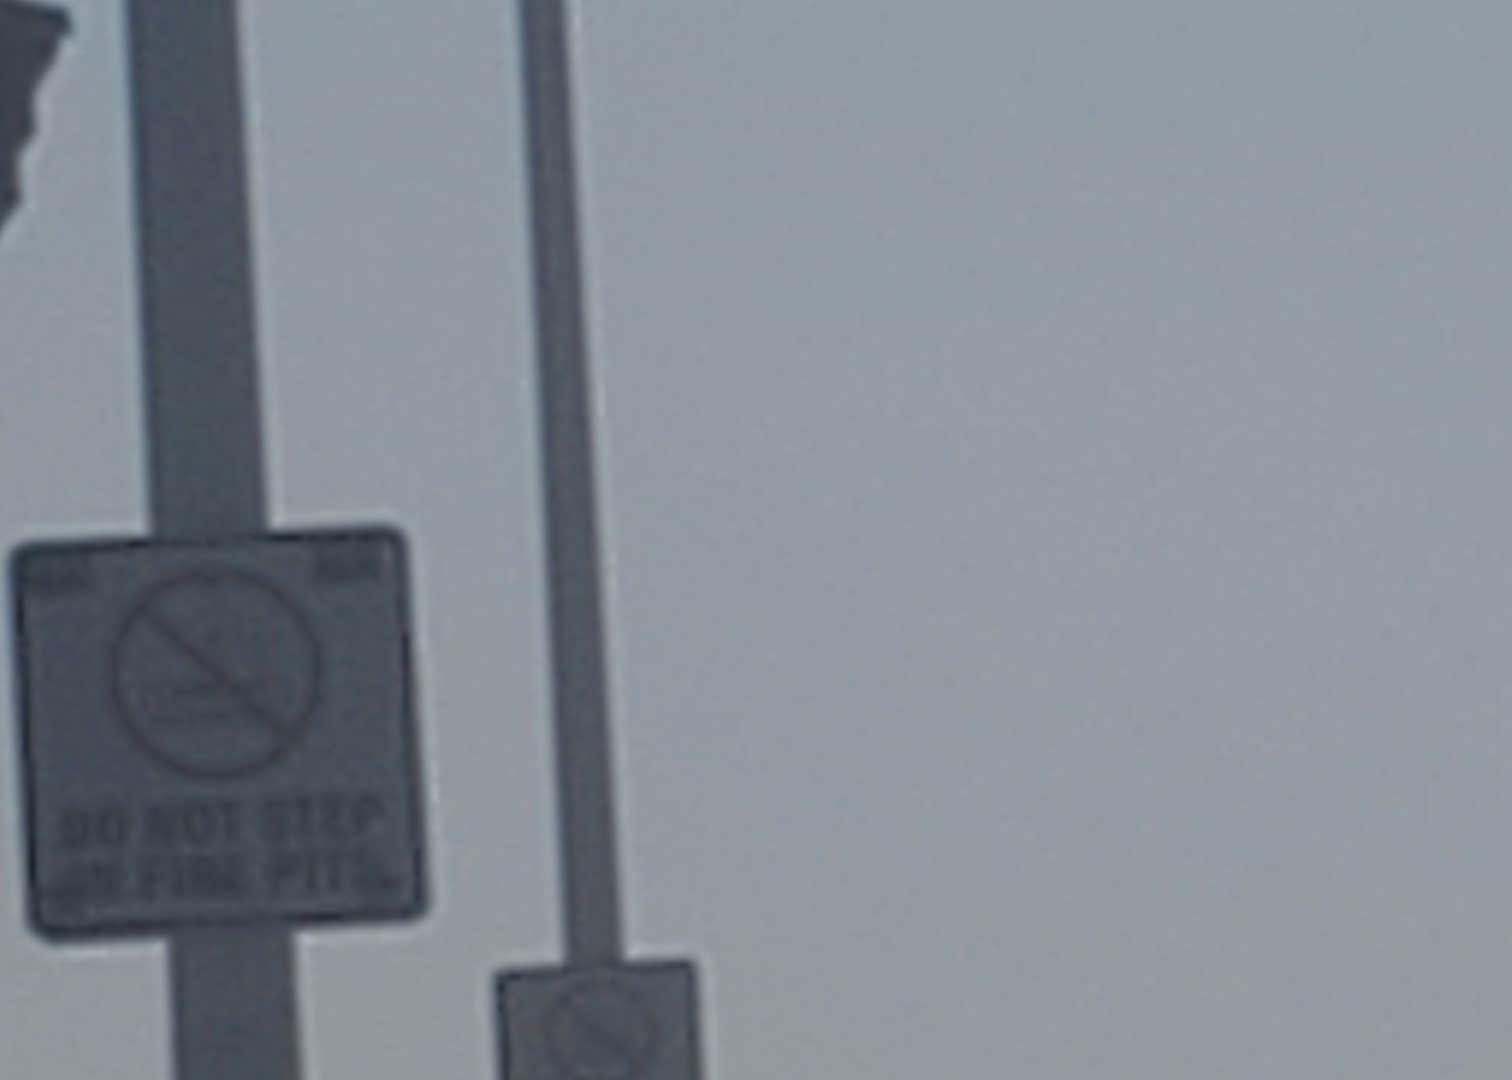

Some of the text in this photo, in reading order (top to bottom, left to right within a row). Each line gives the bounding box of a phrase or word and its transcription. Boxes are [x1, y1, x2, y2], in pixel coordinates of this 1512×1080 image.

[60, 793, 388, 849] DO NOT STEP
